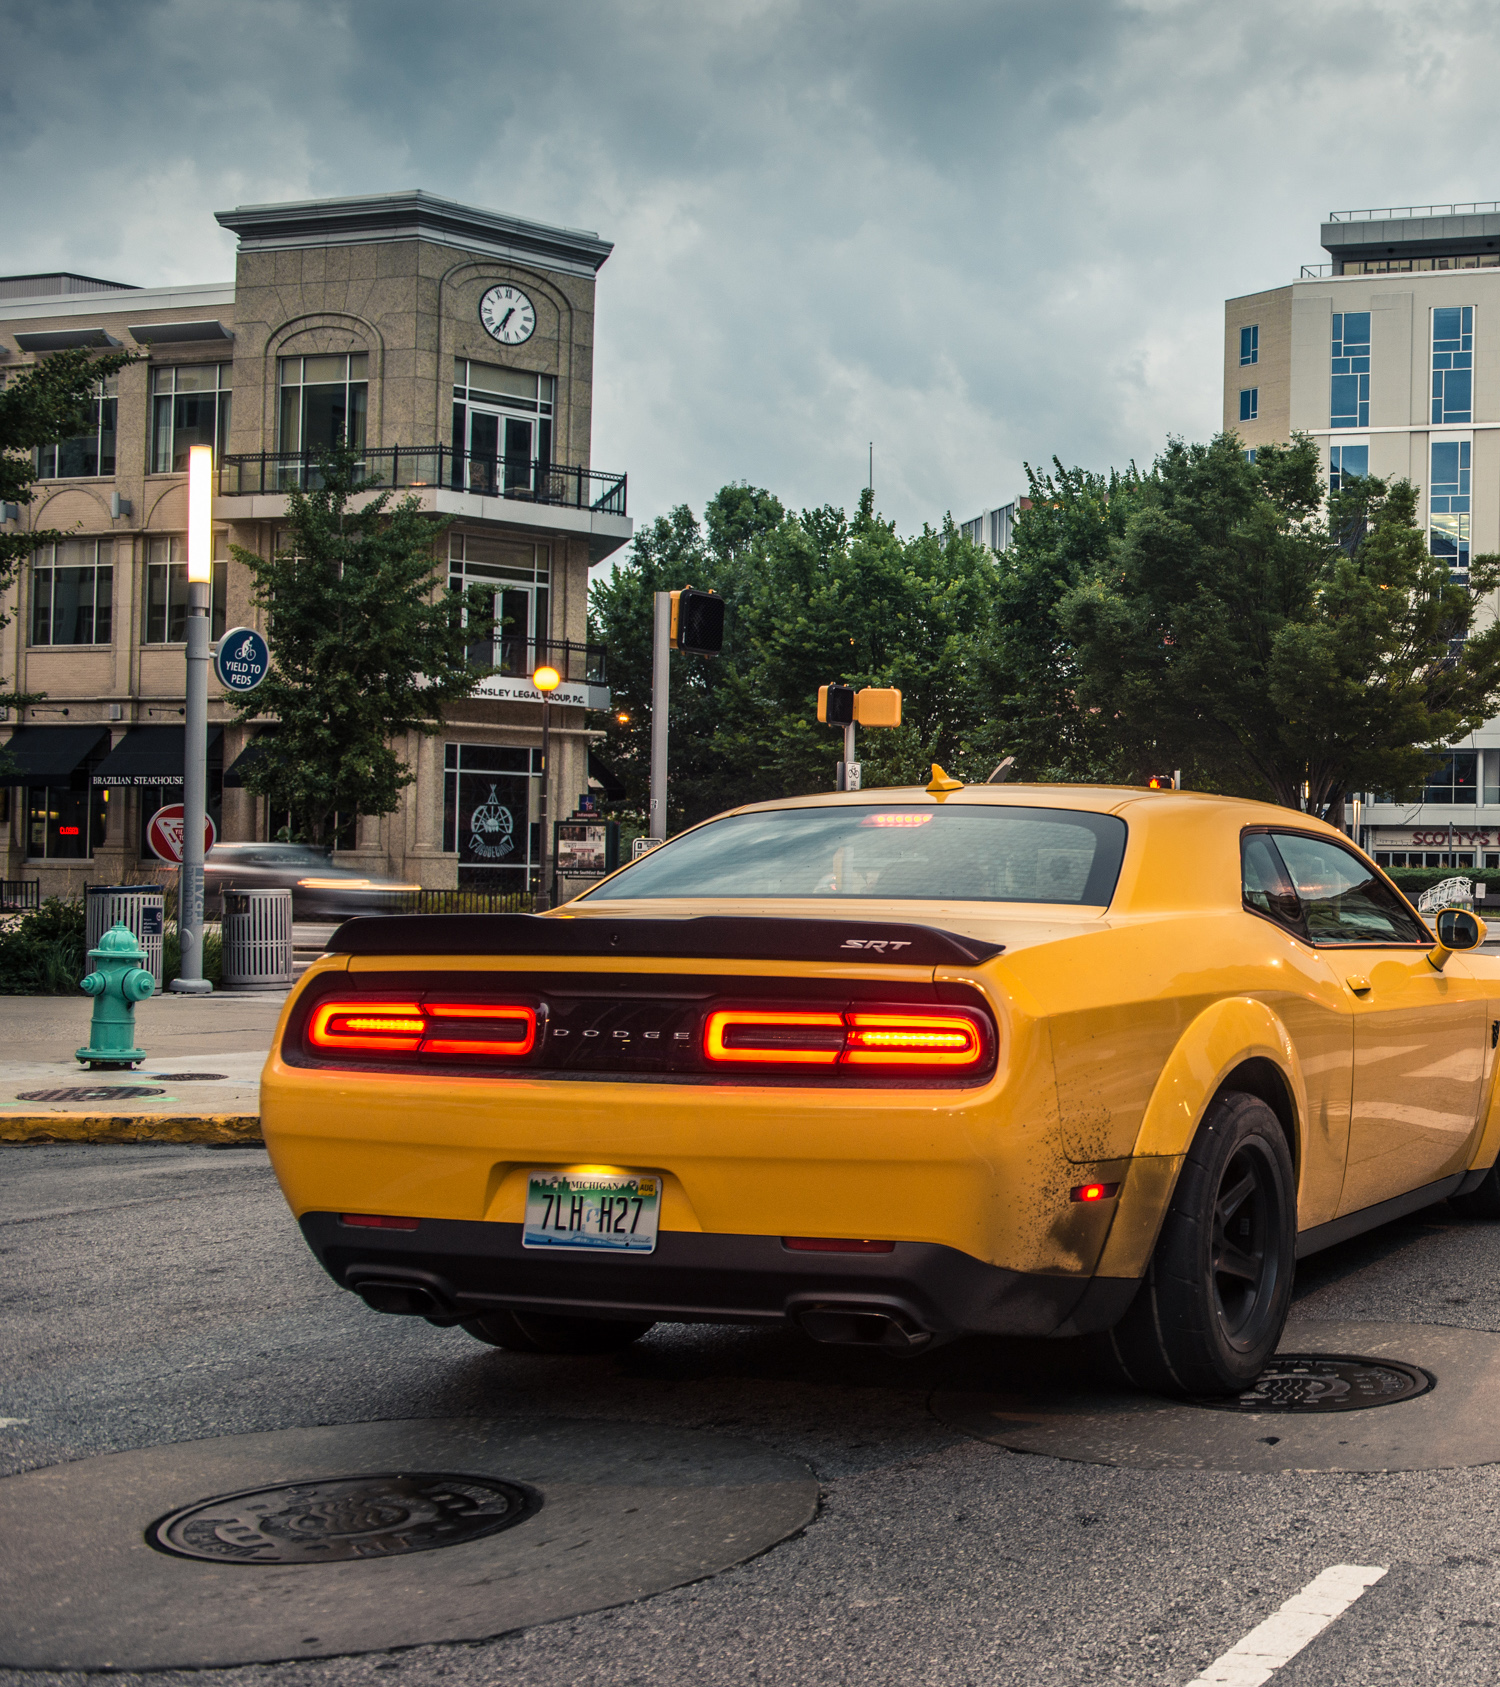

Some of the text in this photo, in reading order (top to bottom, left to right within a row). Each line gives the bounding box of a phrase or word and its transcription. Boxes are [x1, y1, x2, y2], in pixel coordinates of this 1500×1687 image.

[226, 661, 261, 674] YIELD TO
[231, 674, 252, 685] PEDS
[513, 690, 541, 700] LEGAL
[545, 692, 572, 703] ROUP,
[93, 776, 184, 785] BRAZILIAN STEAKHOUSE
[1412, 831, 1490, 845] SCOTTY'S
[840, 939, 912, 953] SRT
[553, 1028, 690, 1040] DODGE
[570, 1180, 619, 1190] MICHIGAN
[639, 1183, 654, 1192] AUG
[541, 1194, 643, 1234] 7LH H27
